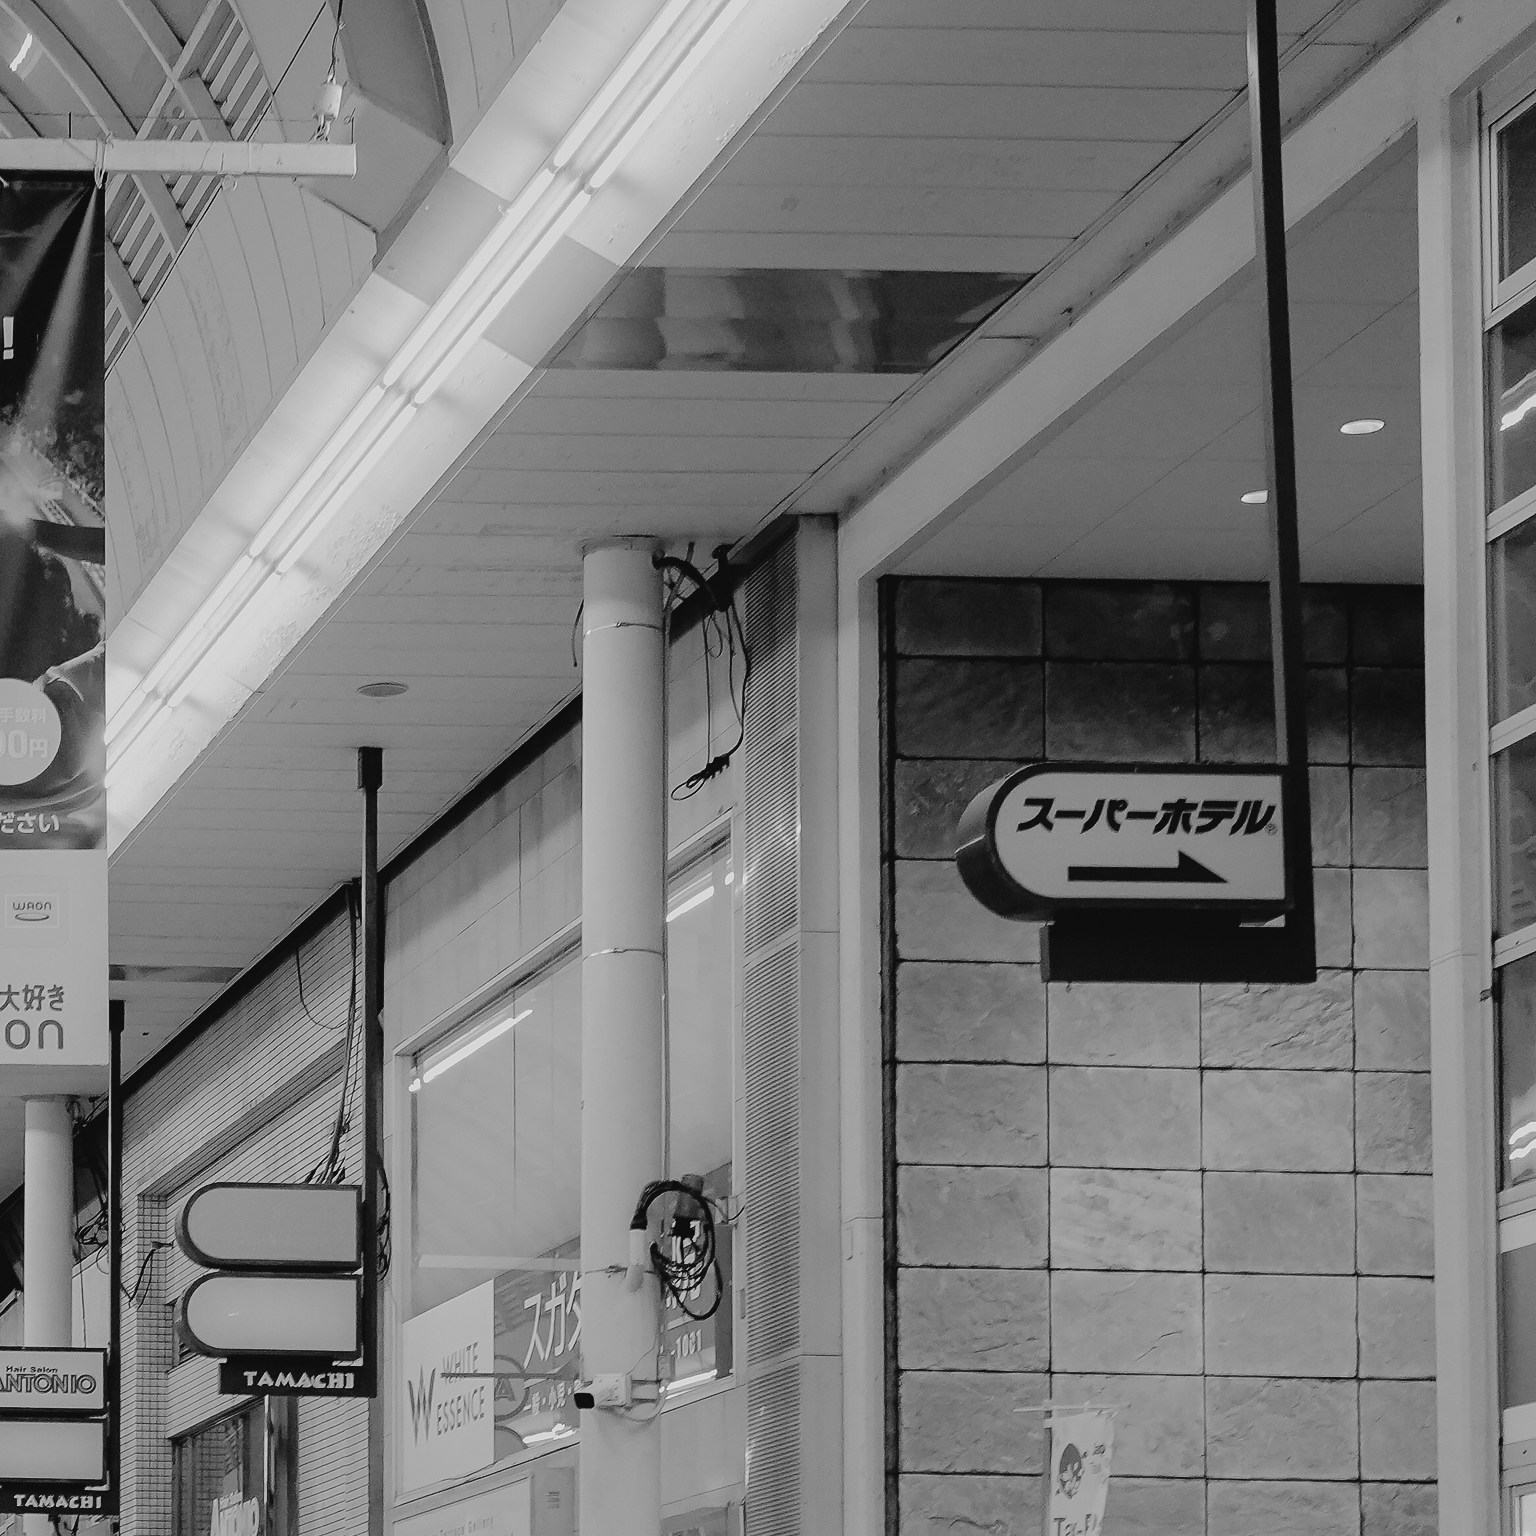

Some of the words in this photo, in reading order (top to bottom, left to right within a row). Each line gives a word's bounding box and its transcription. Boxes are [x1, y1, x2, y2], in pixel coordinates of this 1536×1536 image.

[1016, 797, 1277, 836] スーパーホテル
[12, 899, 53, 913] WAON
[442, 1341, 478, 1373] WHITE
[6, 1365, 27, 1373] Hair
[30, 1366, 59, 1374] Salon
[243, 1371, 355, 1390] TAMACHI
[436, 1385, 485, 1436] ESSENCE
[13, 1493, 102, 1509] TAMACHI
